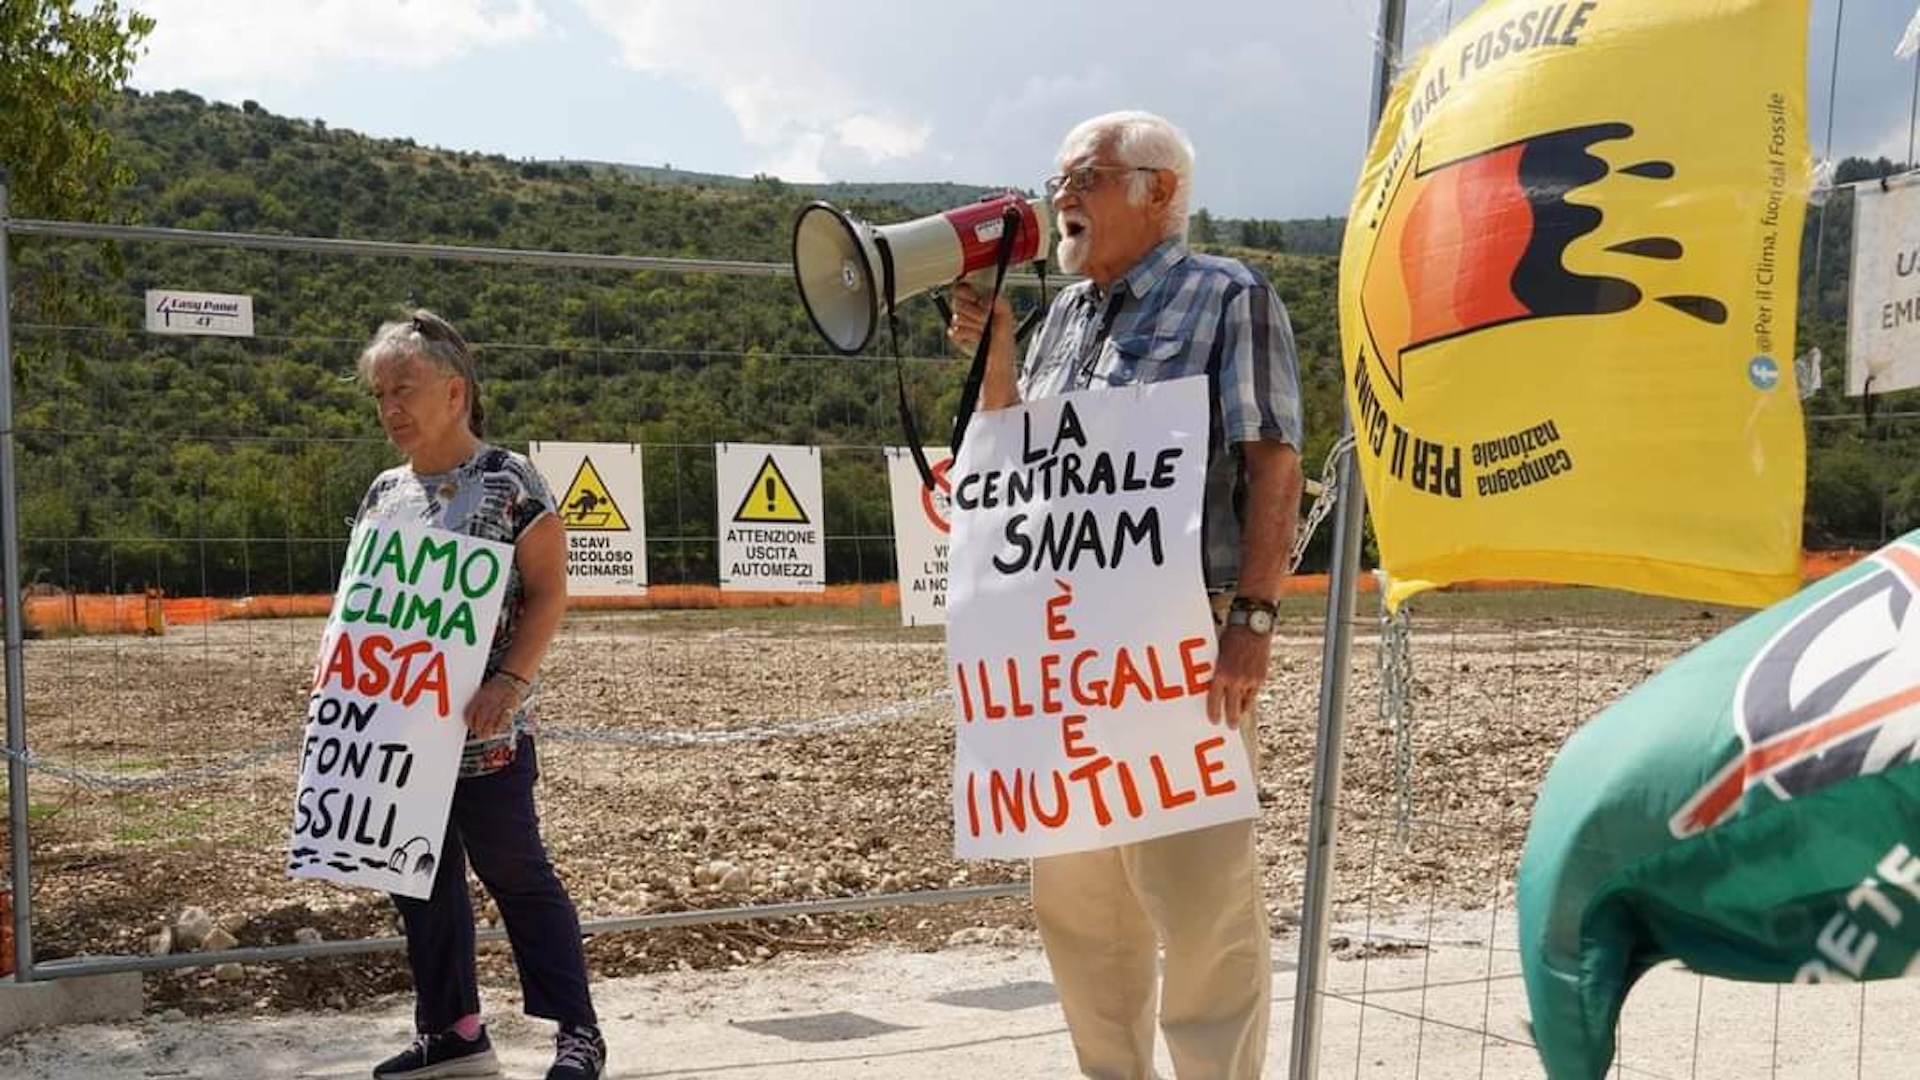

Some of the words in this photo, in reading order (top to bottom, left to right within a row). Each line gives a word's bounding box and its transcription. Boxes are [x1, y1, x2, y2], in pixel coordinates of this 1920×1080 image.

[1410, 66, 1451, 128] DAL
[1459, 2, 1597, 79] FOSSILE
[1766, 92, 1787, 156] Fossile
[1767, 160, 1787, 189] dal
[1761, 190, 1781, 228] fuori
[1756, 231, 1779, 286] Clima,
[1756, 289, 1772, 300] il
[1023, 400, 1087, 466] LA
[1391, 423, 1409, 481] IL
[1471, 419, 1561, 468] nazionale
[956, 448, 1184, 511] CENTRALE
[1412, 438, 1462, 499] PER
[1477, 449, 1573, 497] campagna
[571, 537, 610, 548] SCAVI
[727, 530, 816, 544] ATTENZIONE
[746, 546, 797, 560] USCITA
[992, 506, 1164, 575] SNAM
[731, 563, 813, 577] AUTOMEZZI
[913, 580, 925, 592] AI
[341, 583, 477, 646] CLIMA
[933, 596, 946, 606] AI
[1046, 578, 1076, 641] È
[313, 632, 450, 718] ASTA
[957, 637, 1213, 724] ILLEGALE
[301, 736, 413, 788] FONTI
[1063, 715, 1098, 759] E
[966, 736, 1236, 838] INUTILE
